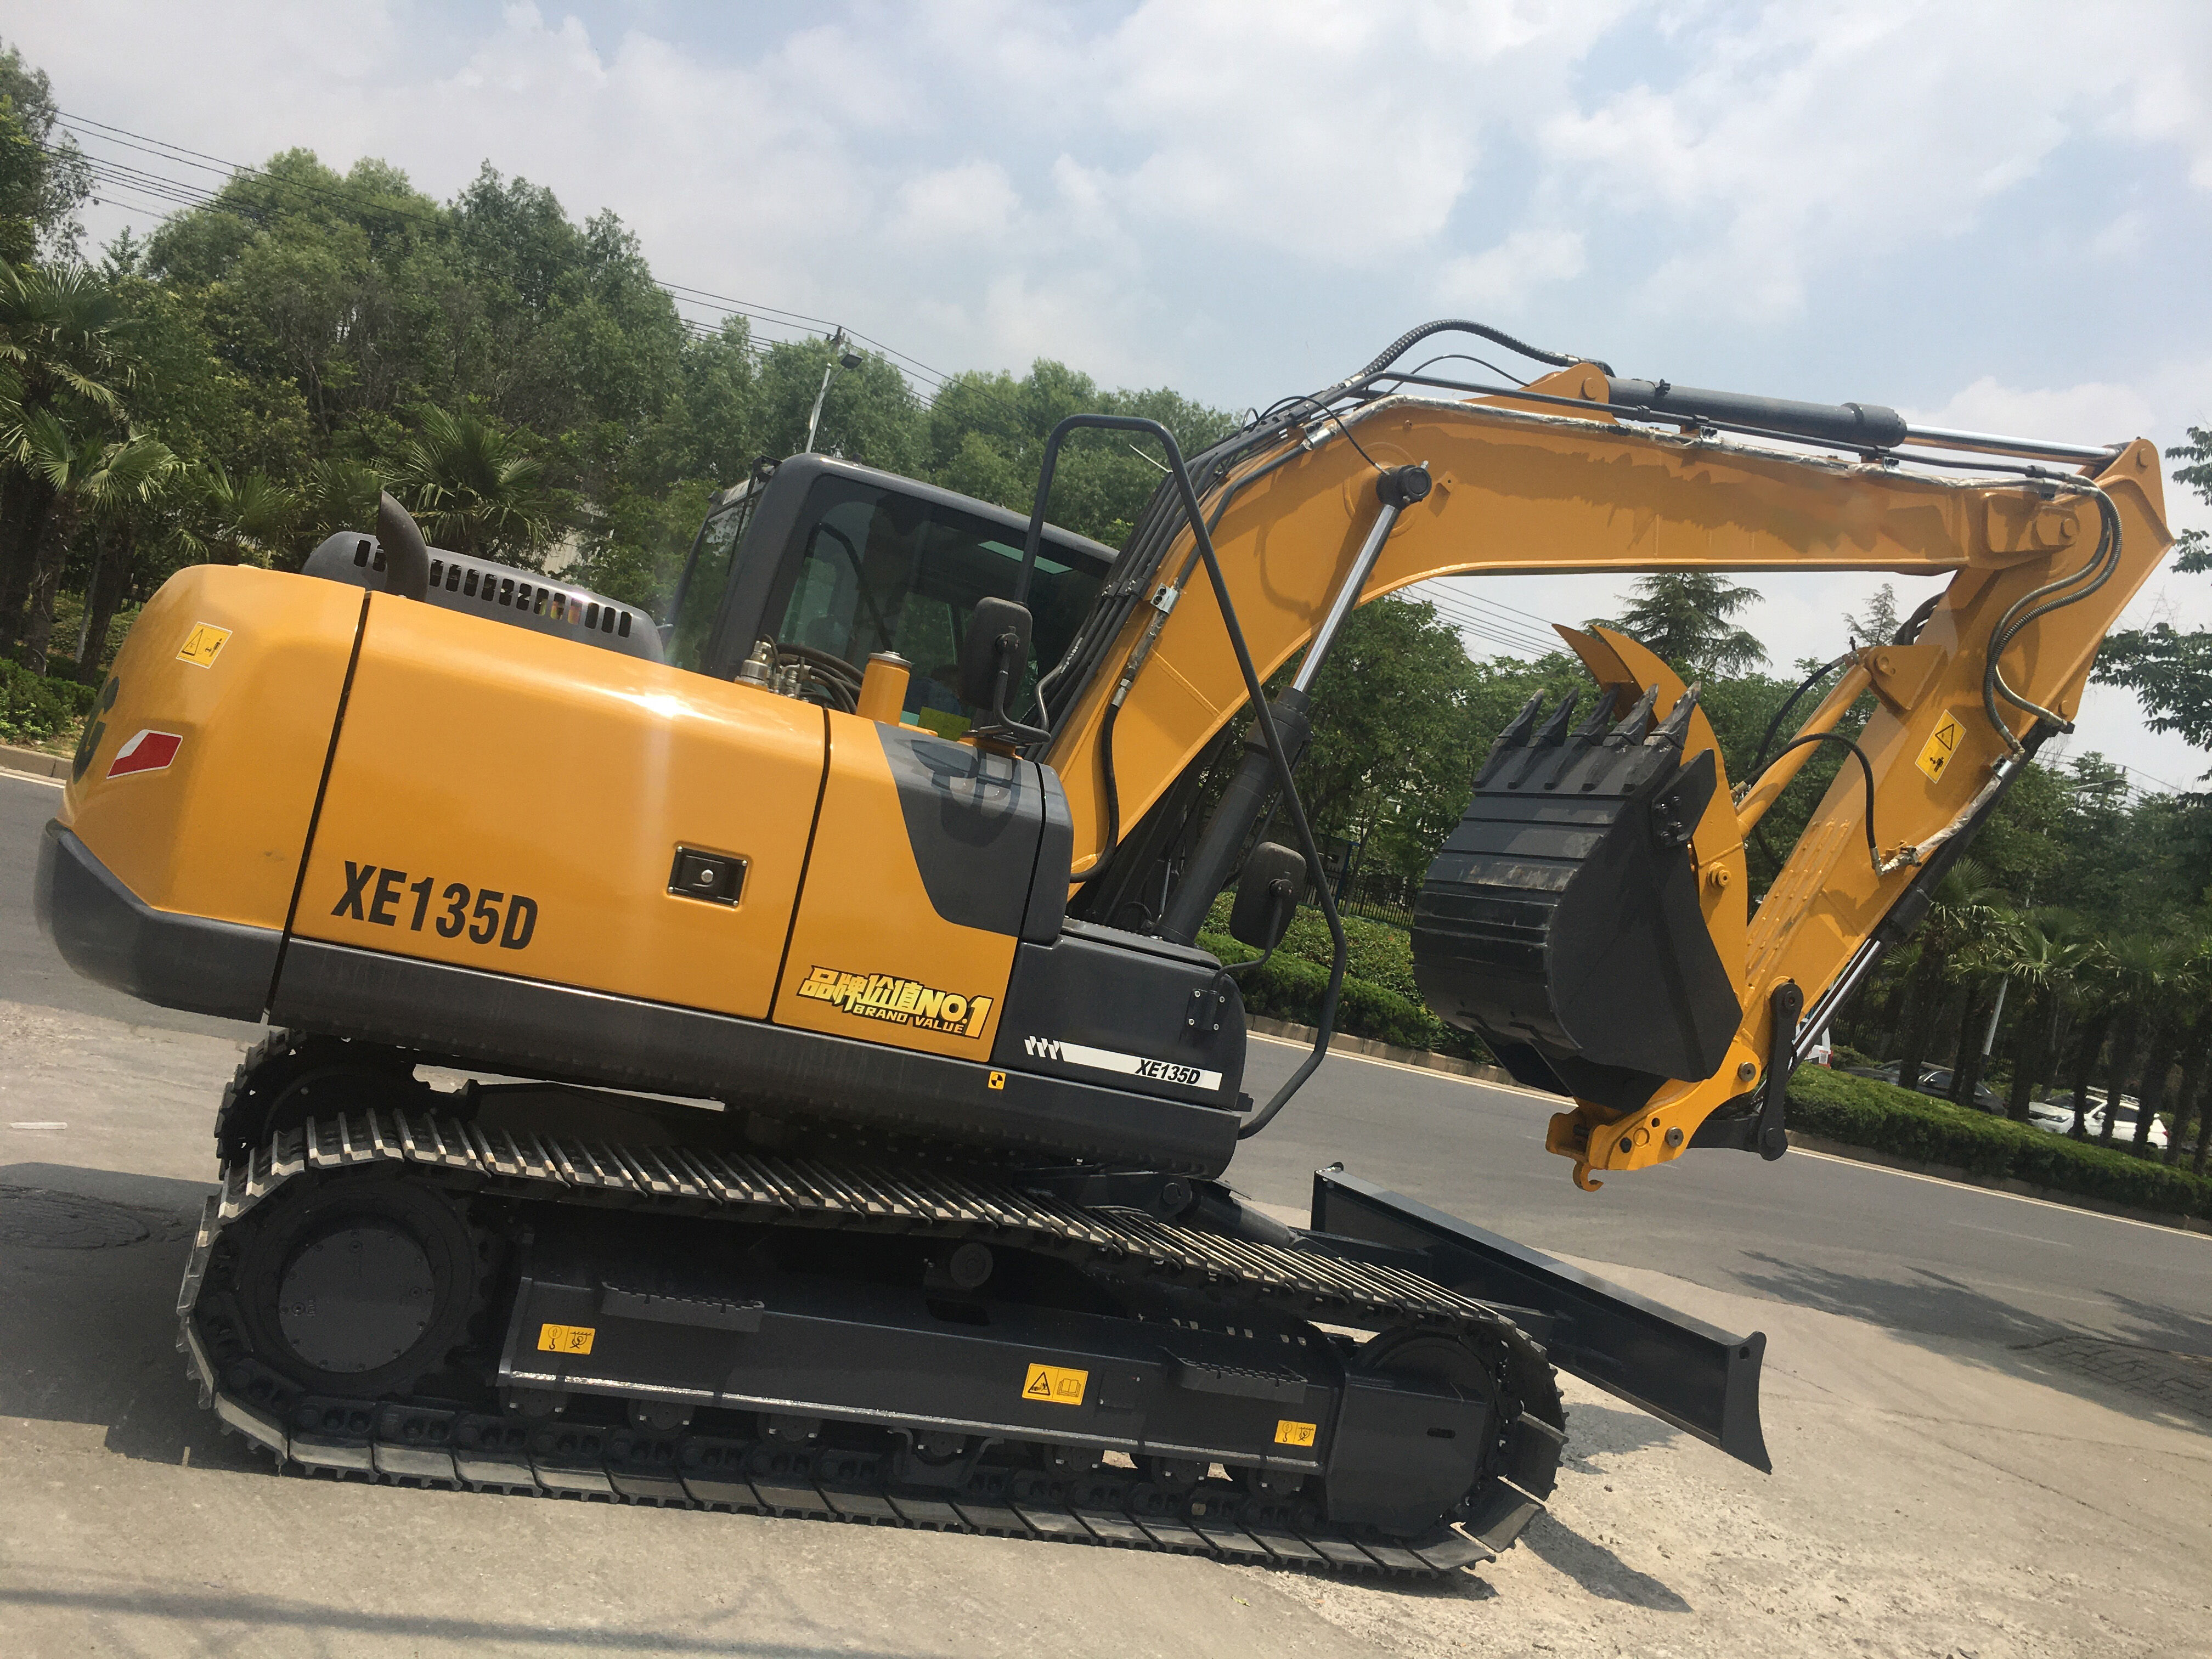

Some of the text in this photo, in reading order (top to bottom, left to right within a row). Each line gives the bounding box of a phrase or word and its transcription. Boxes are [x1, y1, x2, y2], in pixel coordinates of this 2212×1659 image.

[331, 860, 538, 950] XE135D
[853, 1005, 966, 1034] BRAND VALUE
[1134, 1059, 1201, 1085] XE135D
